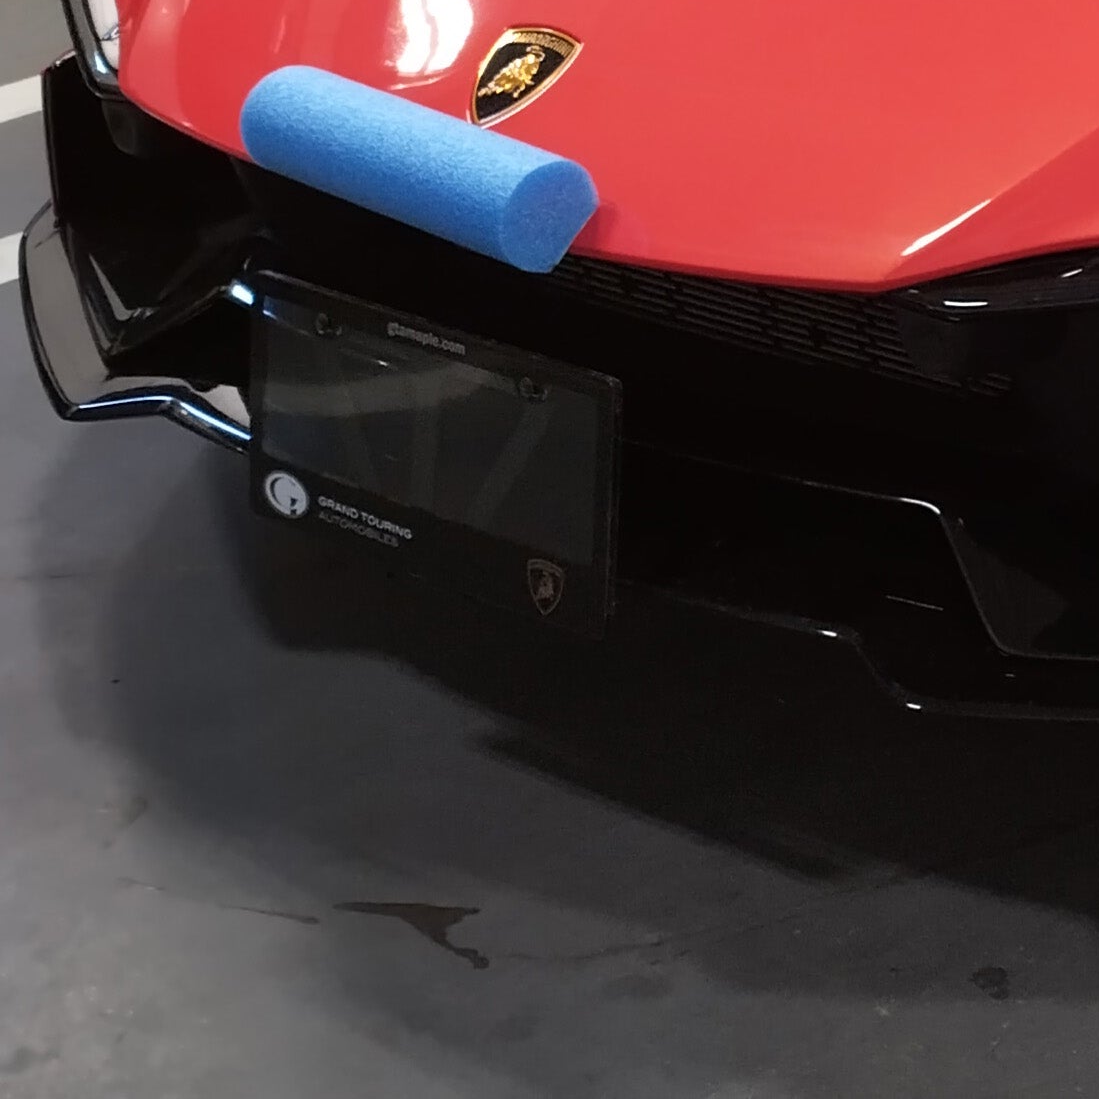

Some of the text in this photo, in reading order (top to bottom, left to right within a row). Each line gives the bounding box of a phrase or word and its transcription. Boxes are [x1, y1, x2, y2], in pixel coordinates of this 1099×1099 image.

[317, 495, 413, 540] GRAND TOURING
[318, 511, 400, 548] AUTOMOBILES
